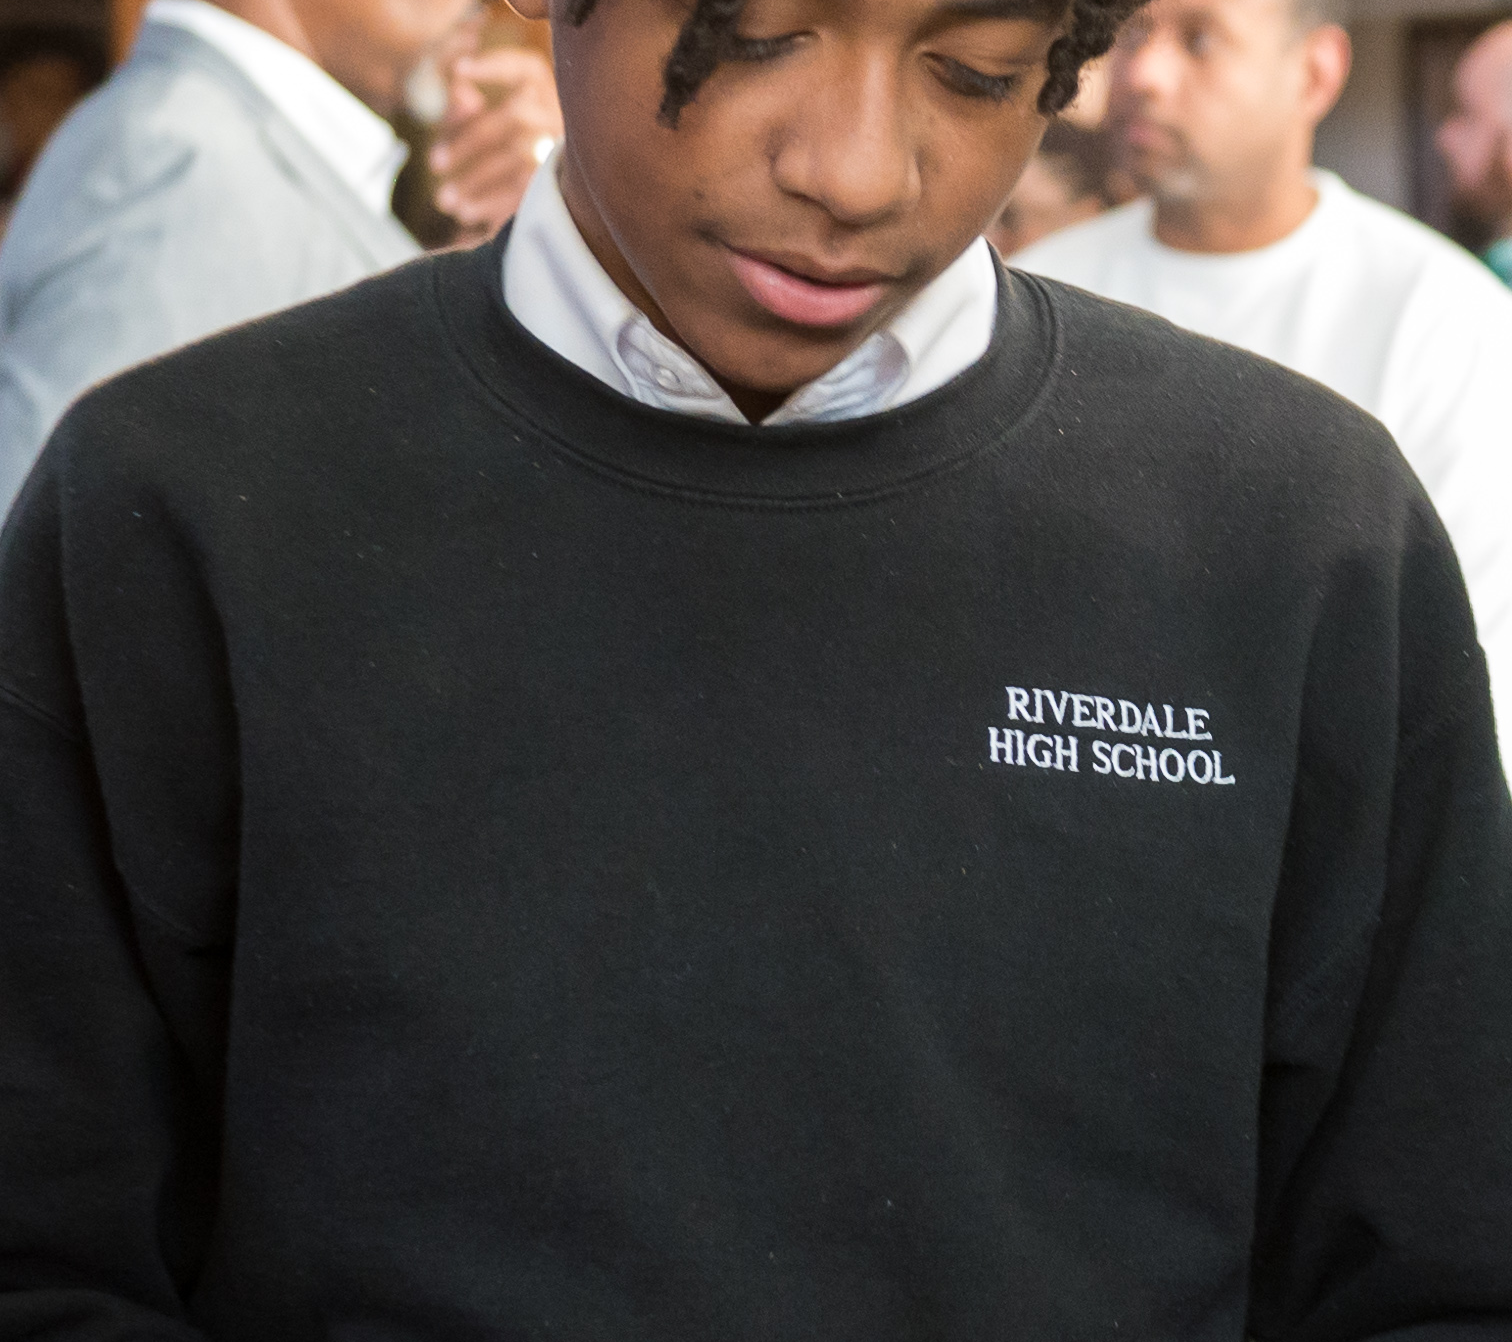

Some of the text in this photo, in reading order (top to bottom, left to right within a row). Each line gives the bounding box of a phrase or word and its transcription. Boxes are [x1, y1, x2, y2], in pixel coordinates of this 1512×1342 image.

[1005, 686, 1213, 741] RIVERDALE
[988, 726, 1236, 785] HIGH SCHOOL
